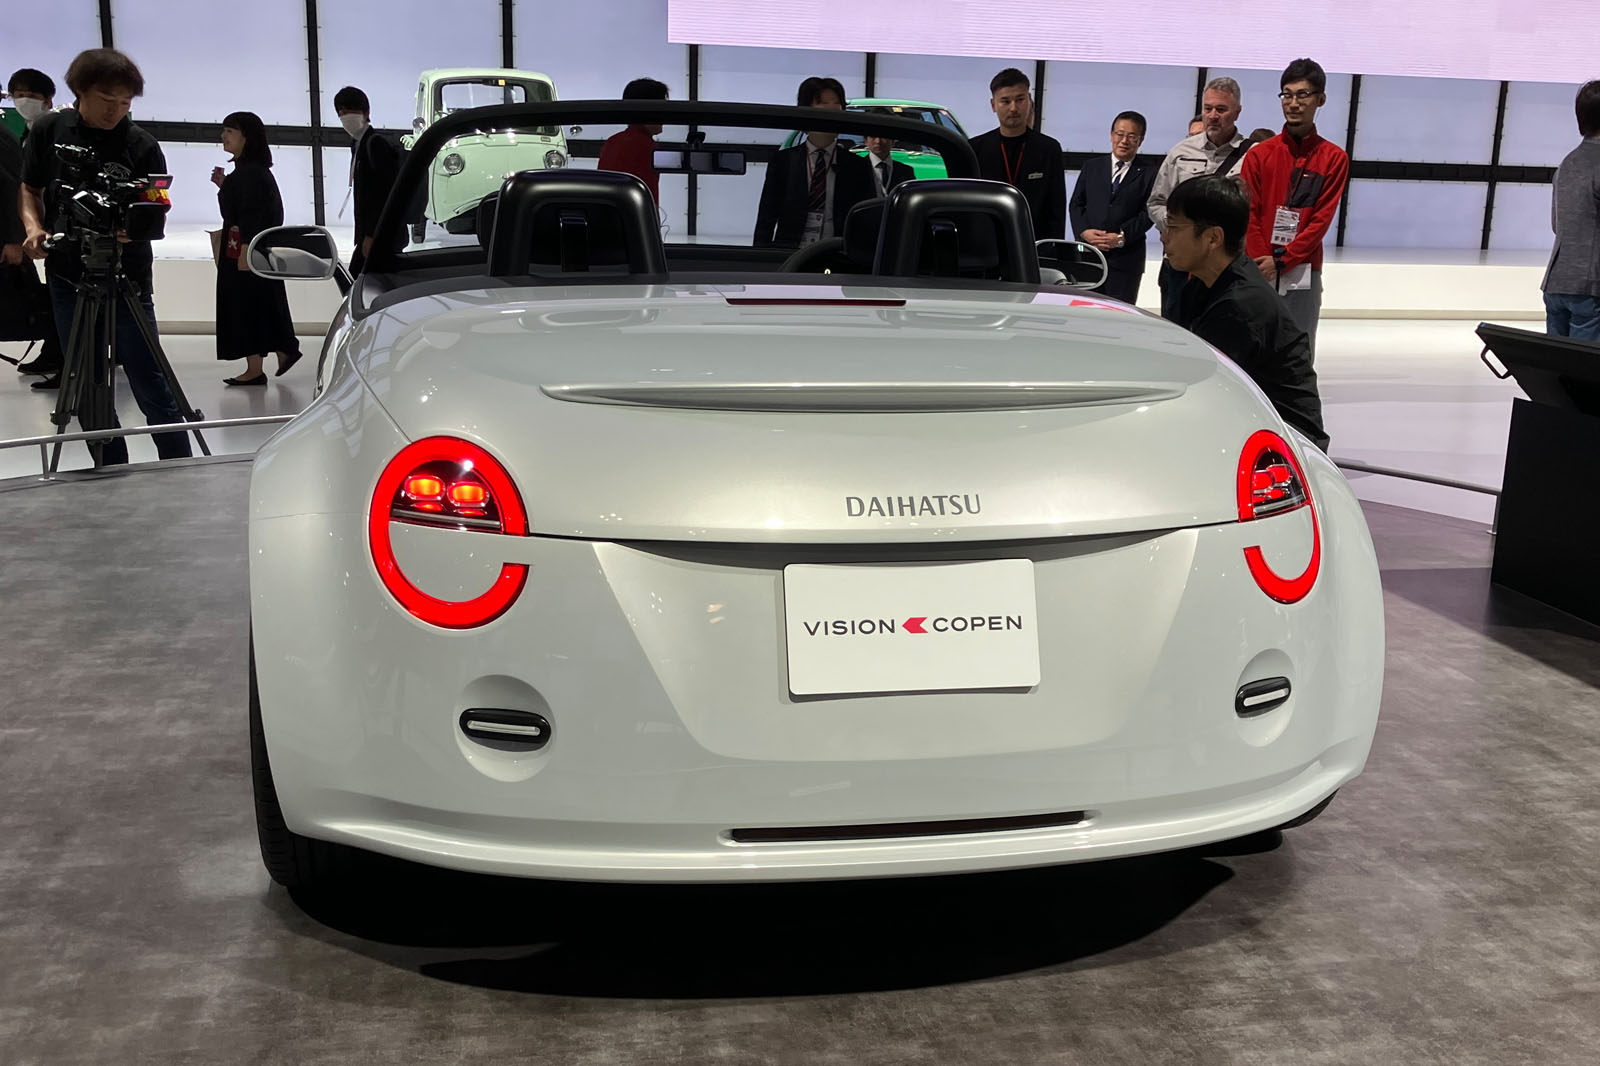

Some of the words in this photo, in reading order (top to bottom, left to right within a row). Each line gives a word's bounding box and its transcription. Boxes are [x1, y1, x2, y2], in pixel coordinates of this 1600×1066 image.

[845, 494, 981, 517] DAIHATSU
[803, 618, 896, 636] VISION
[932, 615, 1022, 633] COPEN
